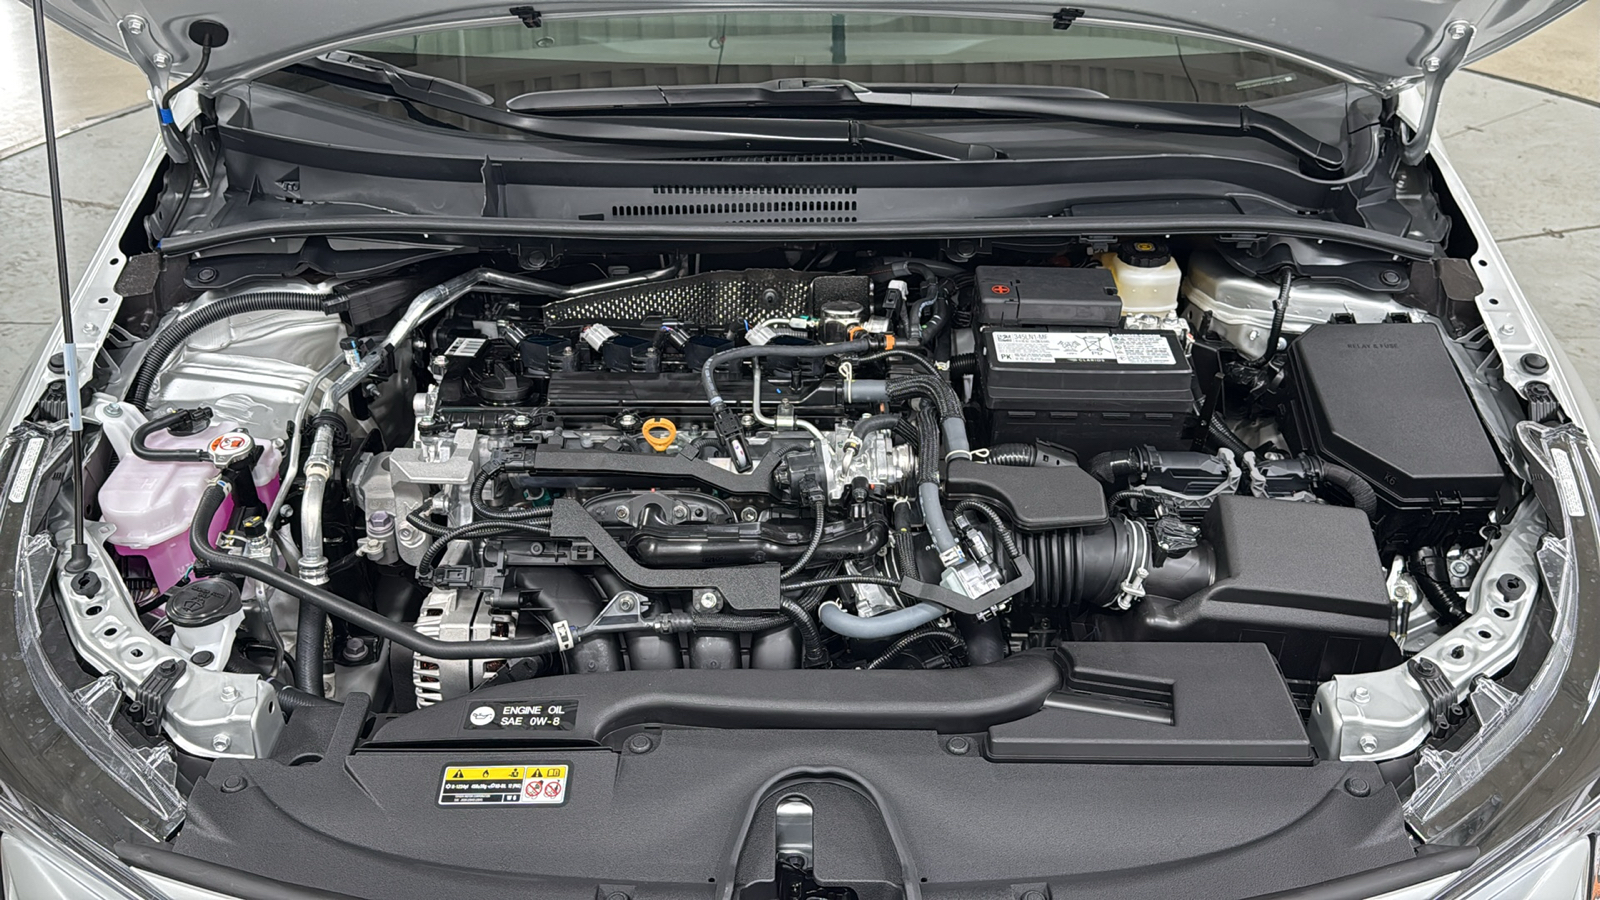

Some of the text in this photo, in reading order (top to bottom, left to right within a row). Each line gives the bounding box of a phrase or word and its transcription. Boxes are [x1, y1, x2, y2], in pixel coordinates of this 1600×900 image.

[1384, 473, 1396, 486] K6
[503, 705, 565, 715] ENGINE OIL
[500, 716, 560, 726] SAE 0W-8
